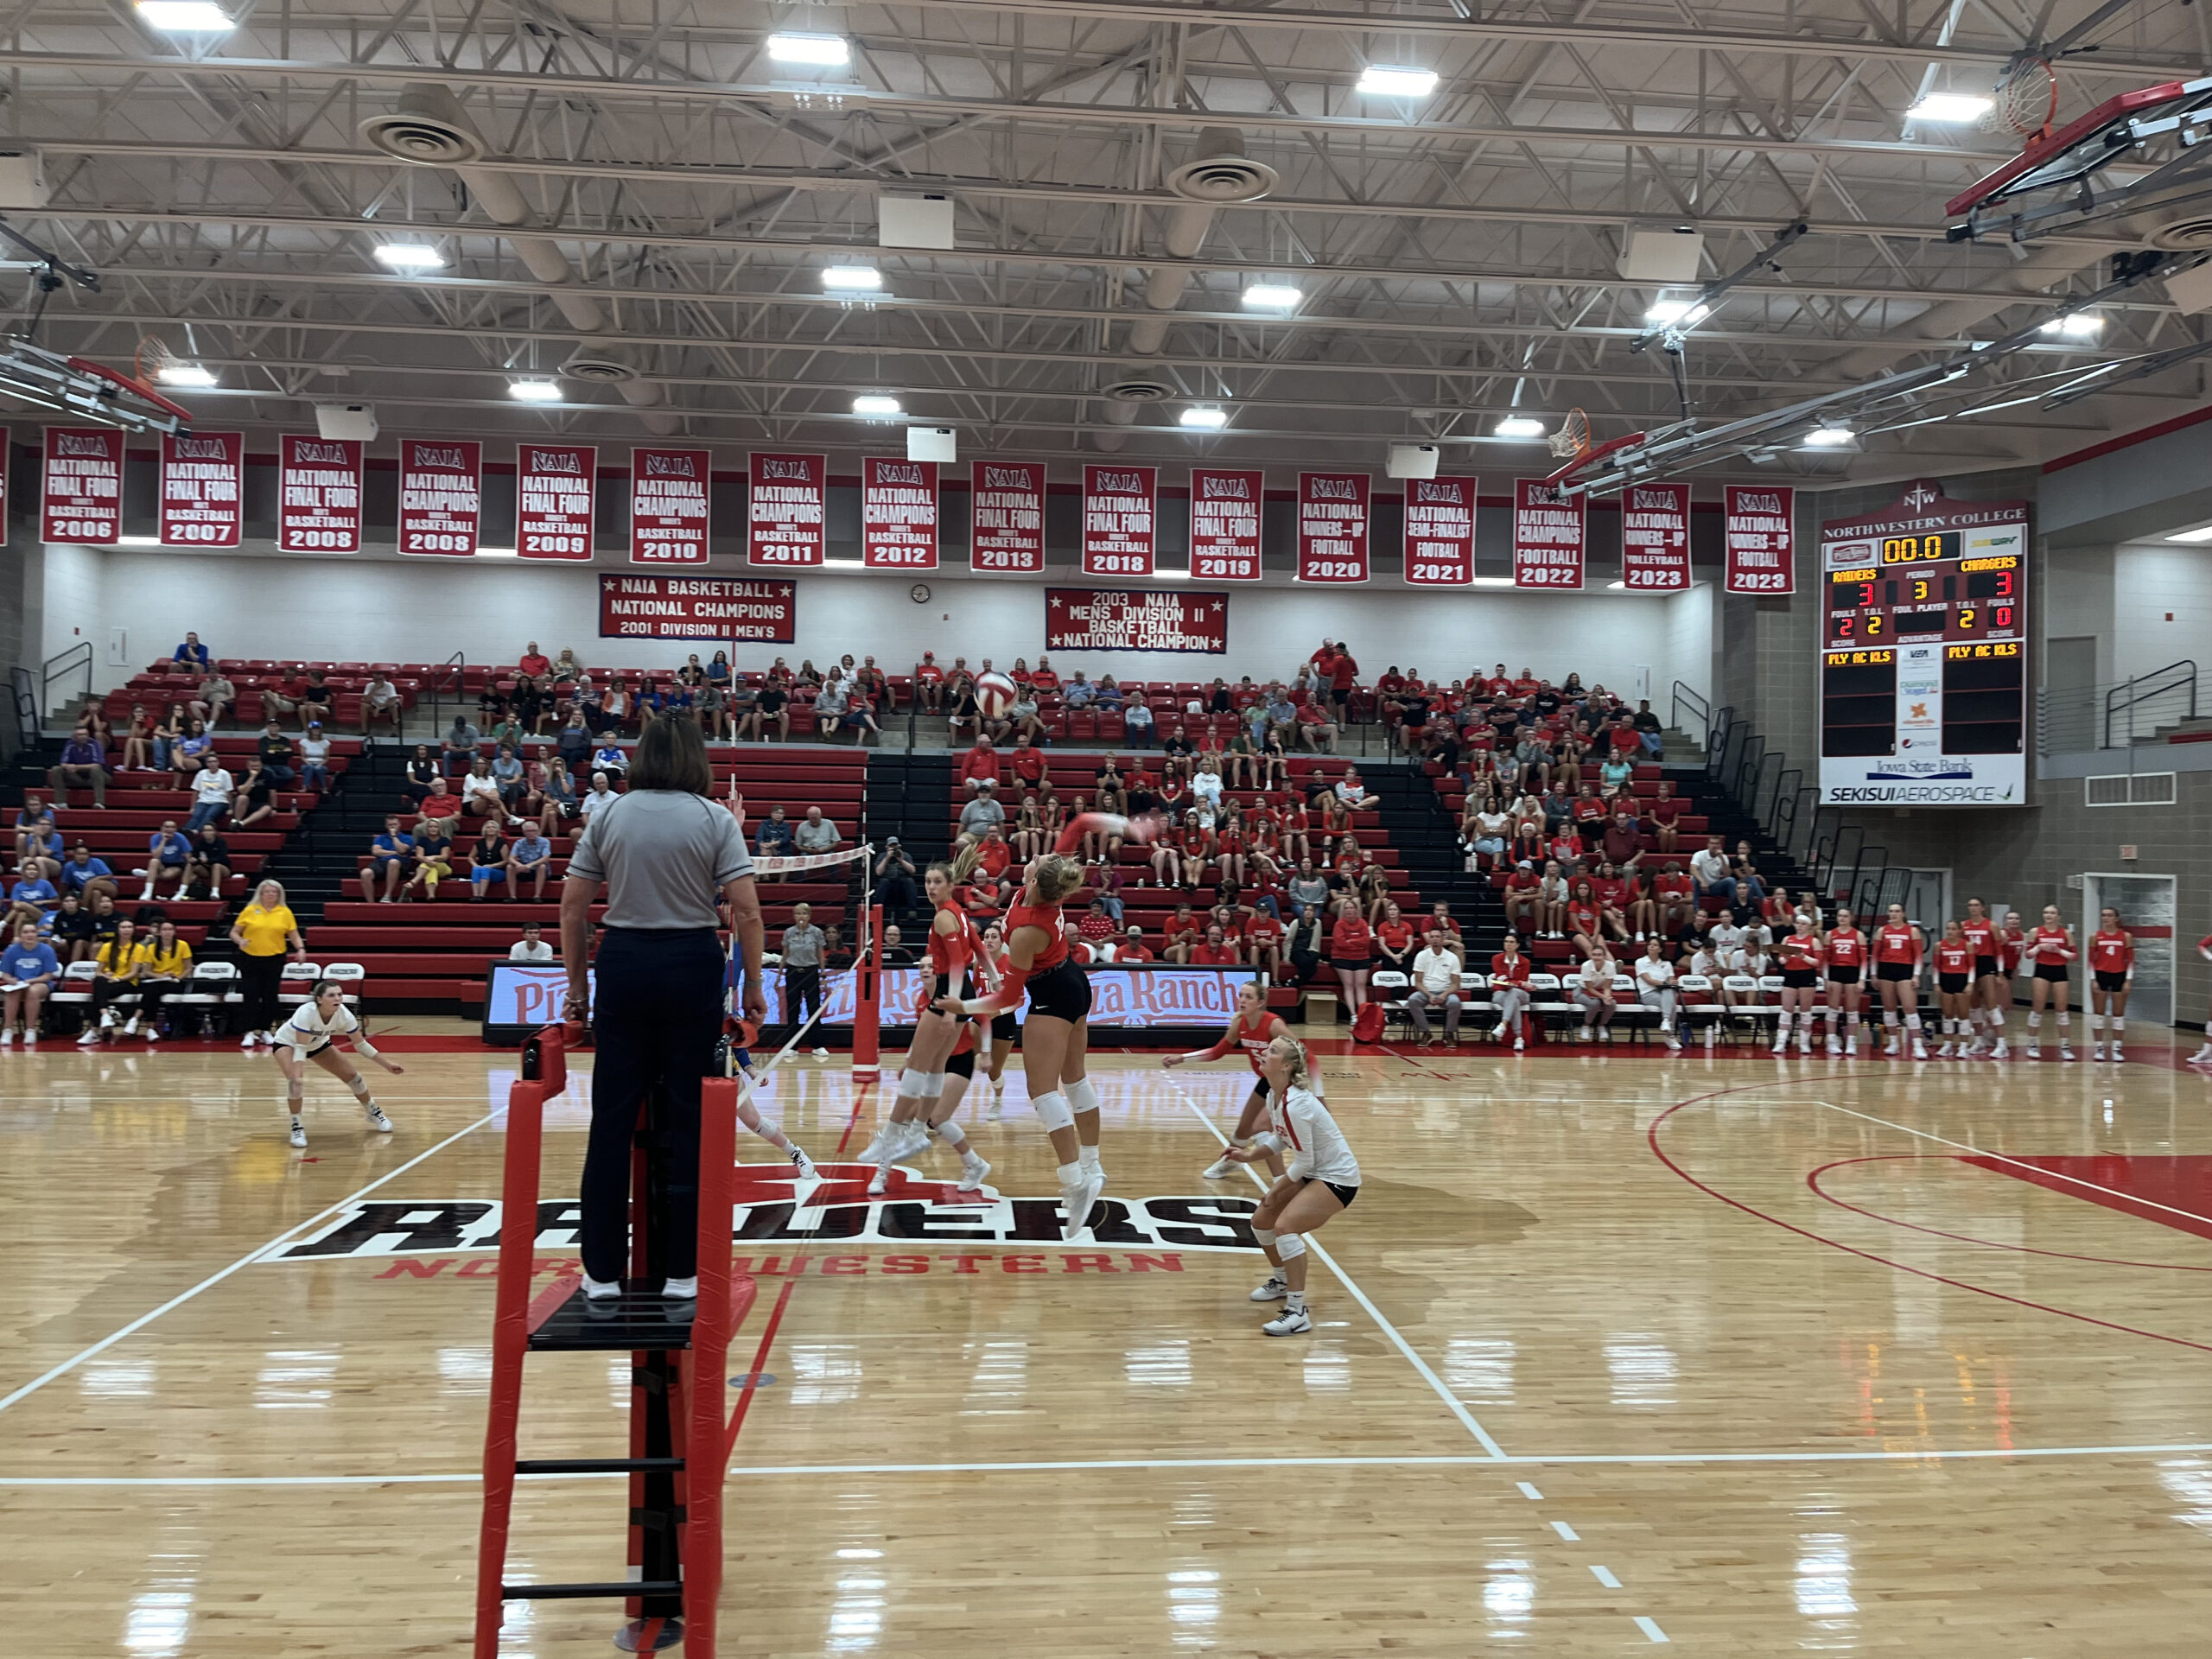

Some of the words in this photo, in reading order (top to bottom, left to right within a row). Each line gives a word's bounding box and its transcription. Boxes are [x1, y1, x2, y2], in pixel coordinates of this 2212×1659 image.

[57, 434, 108, 457] NAIA
[175, 438, 226, 460] NAIA
[295, 441, 347, 465] NAIA
[414, 445, 465, 469] NAIA
[531, 450, 581, 474] NAIA
[646, 454, 695, 477] NAIA
[48, 460, 118, 476] NATIONAL
[166, 463, 236, 480] NATIONAL
[763, 458, 810, 481] NAIA
[876, 462, 923, 485] NAIA
[285, 469, 358, 486] NATIONAL
[406, 474, 475, 491] NATIONAL
[523, 476, 590, 493] NATIONAL
[984, 467, 1031, 490] NAIA
[1096, 471, 1142, 493] NAIA
[48, 476, 82, 496] FINAL
[86, 477, 118, 497] FOUR
[166, 481, 201, 499] FINAL
[205, 481, 237, 501] FOUR
[638, 480, 704, 497] NATIONAL
[754, 486, 820, 503] NATIONAL
[1203, 477, 1249, 499] NAIA
[1312, 478, 1357, 499] NAIA
[1417, 481, 1463, 503] NAIA
[285, 486, 321, 506] FINAL
[325, 487, 357, 507] FOUR
[403, 491, 478, 512] CHAMPIONS
[522, 493, 556, 512] FINAL
[560, 495, 589, 514] FOUR
[868, 488, 933, 505] NATIONAL
[976, 492, 1039, 509] NATIONAL
[1087, 496, 1151, 512] NATIONAL
[1633, 488, 1677, 511] NAIA
[1737, 492, 1782, 513] NAIA
[48, 505, 117, 518] BASKETBALL
[166, 510, 235, 521] BASKETBALL
[635, 497, 706, 518] CHAMPIONS
[752, 503, 822, 524] CHAMPIONS
[866, 505, 935, 524] CHAMPIONS
[1195, 501, 1257, 518] NATIONAL
[1303, 504, 1364, 519] NATIONAL
[1408, 506, 1471, 523] NATIONAL
[285, 516, 356, 528] BASKETBALL
[406, 519, 474, 532] BASKETBALL
[976, 509, 1008, 528] FINAL
[1011, 510, 1039, 529] FOUR
[1087, 512, 1119, 532] FINAL
[1122, 514, 1151, 532] FOUR
[1519, 510, 1580, 526] NATIONAL
[1626, 513, 1684, 529] NATIONAL
[1729, 517, 1789, 531] NATIONAL
[1824, 517, 1946, 539] NORTHWESTERN
[1951, 508, 2025, 525] COLLEGE
[53, 521, 111, 537] 2006
[169, 524, 232, 540] 2007
[523, 522, 588, 534] BASKETBALL
[637, 529, 703, 539] BASKETBALL
[1194, 518, 1226, 537] FINAL
[1229, 518, 1257, 537] FOUR
[1408, 522, 1471, 538] SEMI-FINALIST
[1518, 526, 1580, 544] CHAMPIONS
[289, 531, 352, 547] 2008
[409, 534, 469, 550] 2008
[526, 537, 584, 553] 2009
[754, 531, 818, 543] BASKETBALL
[868, 533, 932, 543] BASKETBALL
[976, 536, 1039, 548] BASKETBALL
[643, 543, 697, 558] 2010
[762, 545, 811, 561] 2011
[874, 547, 926, 563] 2012
[1088, 541, 1149, 552] BASKETBALL
[1196, 545, 1256, 556] BASKETBALL
[1312, 539, 1354, 556] FOOTBALL
[1417, 543, 1460, 558] FOOTBALL
[1885, 536, 1942, 563] 00.0
[982, 551, 1033, 567] 2013
[1093, 556, 1144, 571] 2018
[1517, 549, 1579, 565] FOOTBALL
[1626, 555, 1684, 565] VOLLEYBALL
[1738, 552, 1779, 567] FOOTBALL
[1961, 556, 2017, 572] CHARGERS
[1200, 560, 1251, 575] 2019
[1307, 562, 1361, 577] 2020
[1413, 564, 1464, 580] 2021
[1522, 568, 1574, 583] 2022
[1833, 569, 1877, 583] RAIDERS
[1630, 570, 1681, 586] 2023
[1734, 573, 1785, 588] 2023
[1997, 571, 2012, 595] 3
[621, 579, 658, 594] NAIA
[668, 581, 773, 597] BASKETBALL
[1859, 583, 1873, 606] 3
[1915, 581, 1928, 600] 3
[1093, 592, 1128, 607] 2003
[1145, 594, 1179, 607] NAIA
[611, 600, 687, 615] NATIONAL
[695, 602, 785, 620] CHAMPIONS
[1070, 606, 1110, 620] MENS
[1123, 607, 1184, 621] DIVISION
[1194, 608, 1204, 622] II
[1960, 609, 1974, 628] 2
[1996, 607, 2012, 626] 0
[620, 621, 652, 633] 2001
[661, 623, 717, 636] DIVISION
[722, 625, 730, 636] II
[735, 626, 775, 638] MEN'S
[1089, 620, 1183, 635] BASKETBALL
[1840, 618, 1853, 636] 2
[1867, 616, 1881, 634] 2
[1064, 633, 1134, 647] NATIONAL
[1137, 634, 1209, 650] CHAMPION
[1877, 760, 1907, 772] Iowa
[1909, 760, 1936, 772] State
[1940, 758, 1973, 772] Bank
[1835, 944, 1852, 954] 22
[1128, 971, 1239, 1014] Ranch
